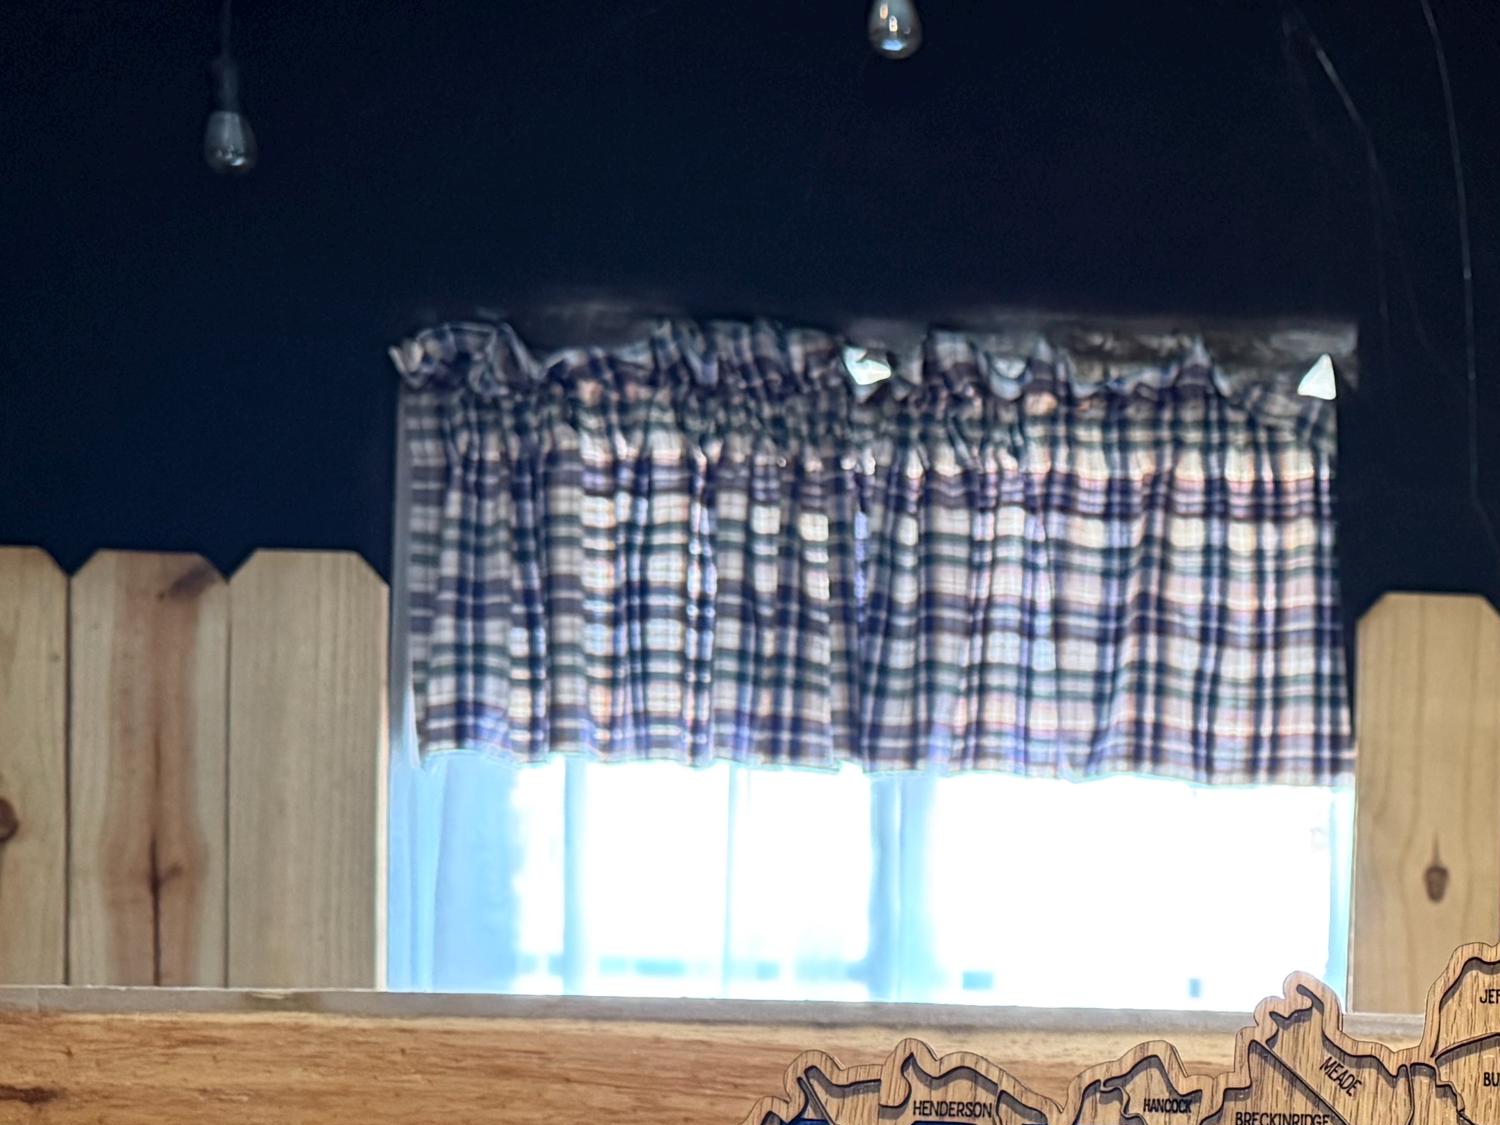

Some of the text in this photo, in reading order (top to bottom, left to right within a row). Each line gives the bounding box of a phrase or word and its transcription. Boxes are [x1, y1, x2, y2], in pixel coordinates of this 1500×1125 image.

[1319, 1056, 1362, 1096] MEADE
[913, 1101, 992, 1118] HENDERSON
[1144, 1098, 1192, 1113] HANCOCK
